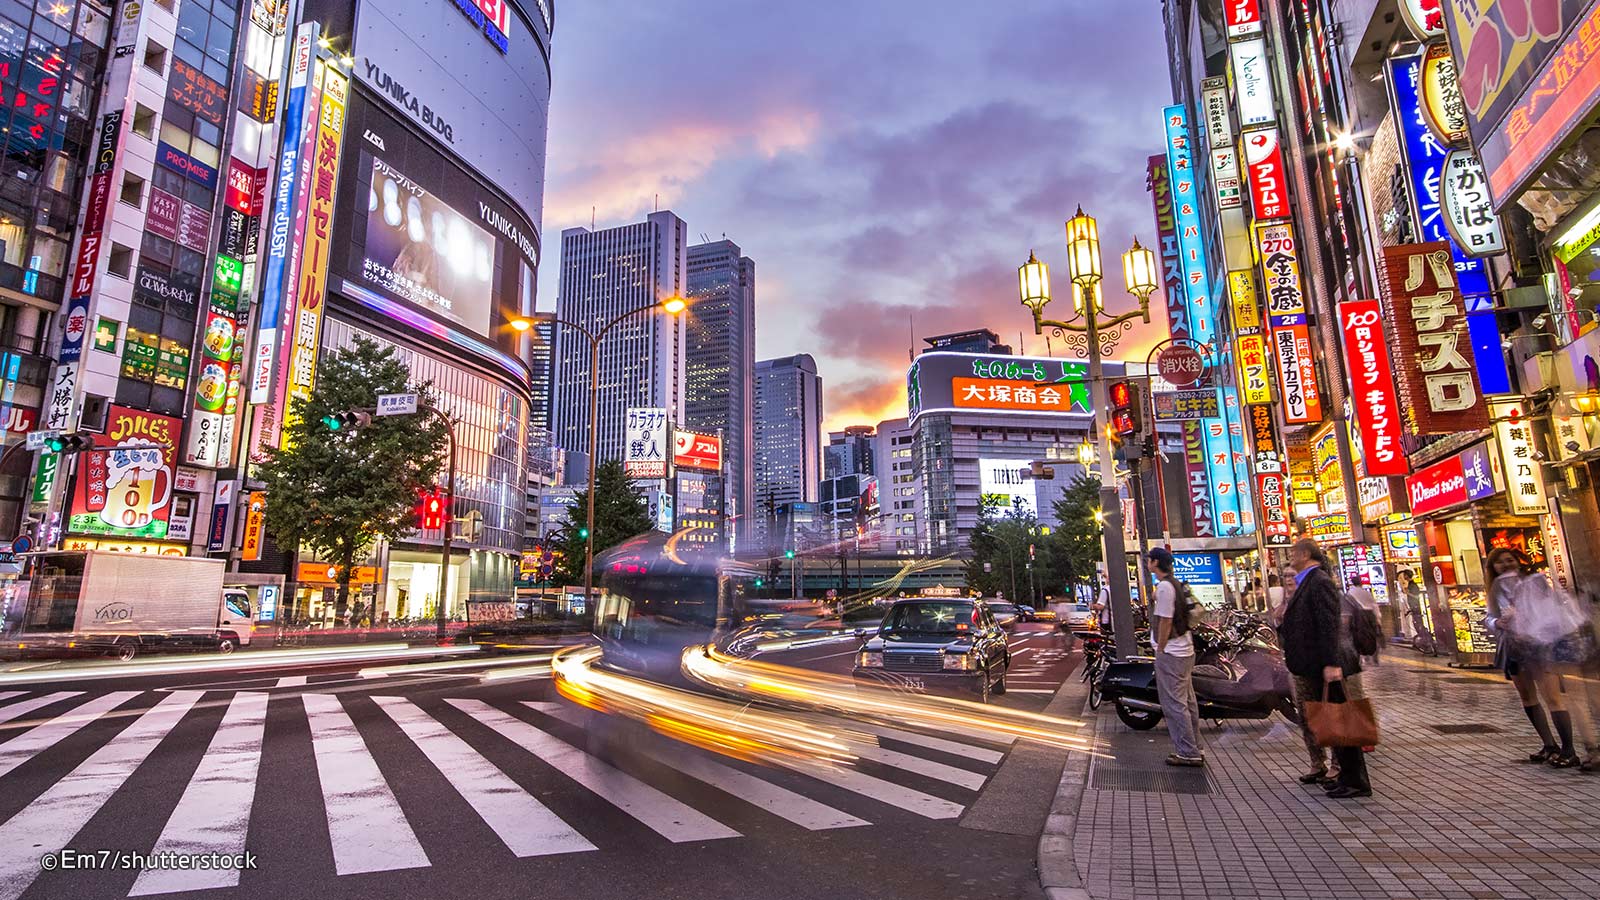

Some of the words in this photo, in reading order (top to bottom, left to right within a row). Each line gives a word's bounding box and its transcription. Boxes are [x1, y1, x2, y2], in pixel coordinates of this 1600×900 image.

[298, 46, 309, 73] LABI
[172, 87, 222, 123] マッサージ
[184, 81, 214, 106] オイル
[327, 83, 346, 100] LABI
[365, 57, 420, 117] YUNIKA
[422, 105, 455, 144] BLDG.
[1435, 60, 1466, 131] お好み焼き
[166, 150, 209, 181] PROMISE
[231, 167, 252, 183] FAST
[374, 159, 426, 198] クリープハイプ
[229, 178, 251, 195] NAIL
[1153, 161, 1175, 232] パチンコ
[1257, 163, 1279, 205] アコム
[154, 197, 175, 210] FAST
[1264, 205, 1281, 216] 3F
[1456, 168, 1494, 228] かっぱ
[153, 205, 174, 220] NAIL
[301, 131, 338, 310] 決算セール
[271, 213, 289, 258] JUST
[479, 201, 519, 241] YUNIKA
[518, 236, 537, 266] VISION
[1263, 238, 1293, 253] 270
[1471, 232, 1496, 246] B1
[75, 237, 98, 293] アイフル
[1454, 261, 1477, 271] 3F
[1161, 235, 1189, 333] エスパス
[1266, 251, 1302, 311] 金の蔵
[67, 315, 85, 334] 薬
[1281, 315, 1298, 326] 2F
[1405, 250, 1477, 413] パチスロ
[127, 342, 155, 357] 肩こり
[259, 358, 270, 389] LABI
[972, 359, 1047, 381] たのめーる
[1162, 356, 1200, 374] 消火栓
[1277, 330, 1303, 417] 東京チカラめし
[1299, 357, 1317, 399] 焼き牛丼
[49, 366, 75, 429] 大勝軒
[962, 385, 1062, 405] 大塚商会
[1252, 391, 1264, 401] 6F
[629, 410, 666, 429] カラオケ
[1252, 405, 1273, 450] お好み焼
[111, 415, 175, 463] カルビちゃん
[630, 441, 662, 458] 鉄人
[642, 430, 651, 442] の
[696, 441, 718, 454] アコム
[1261, 462, 1275, 471] 8F
[1509, 427, 1538, 496] 養老乃瀧
[40, 457, 56, 495] レイク
[1190, 470, 1215, 536] エスパス
[1263, 476, 1284, 523] 居酒屋
[1271, 534, 1287, 544] 4F
[1172, 556, 1212, 568] NADE
[264, 588, 273, 601] P
